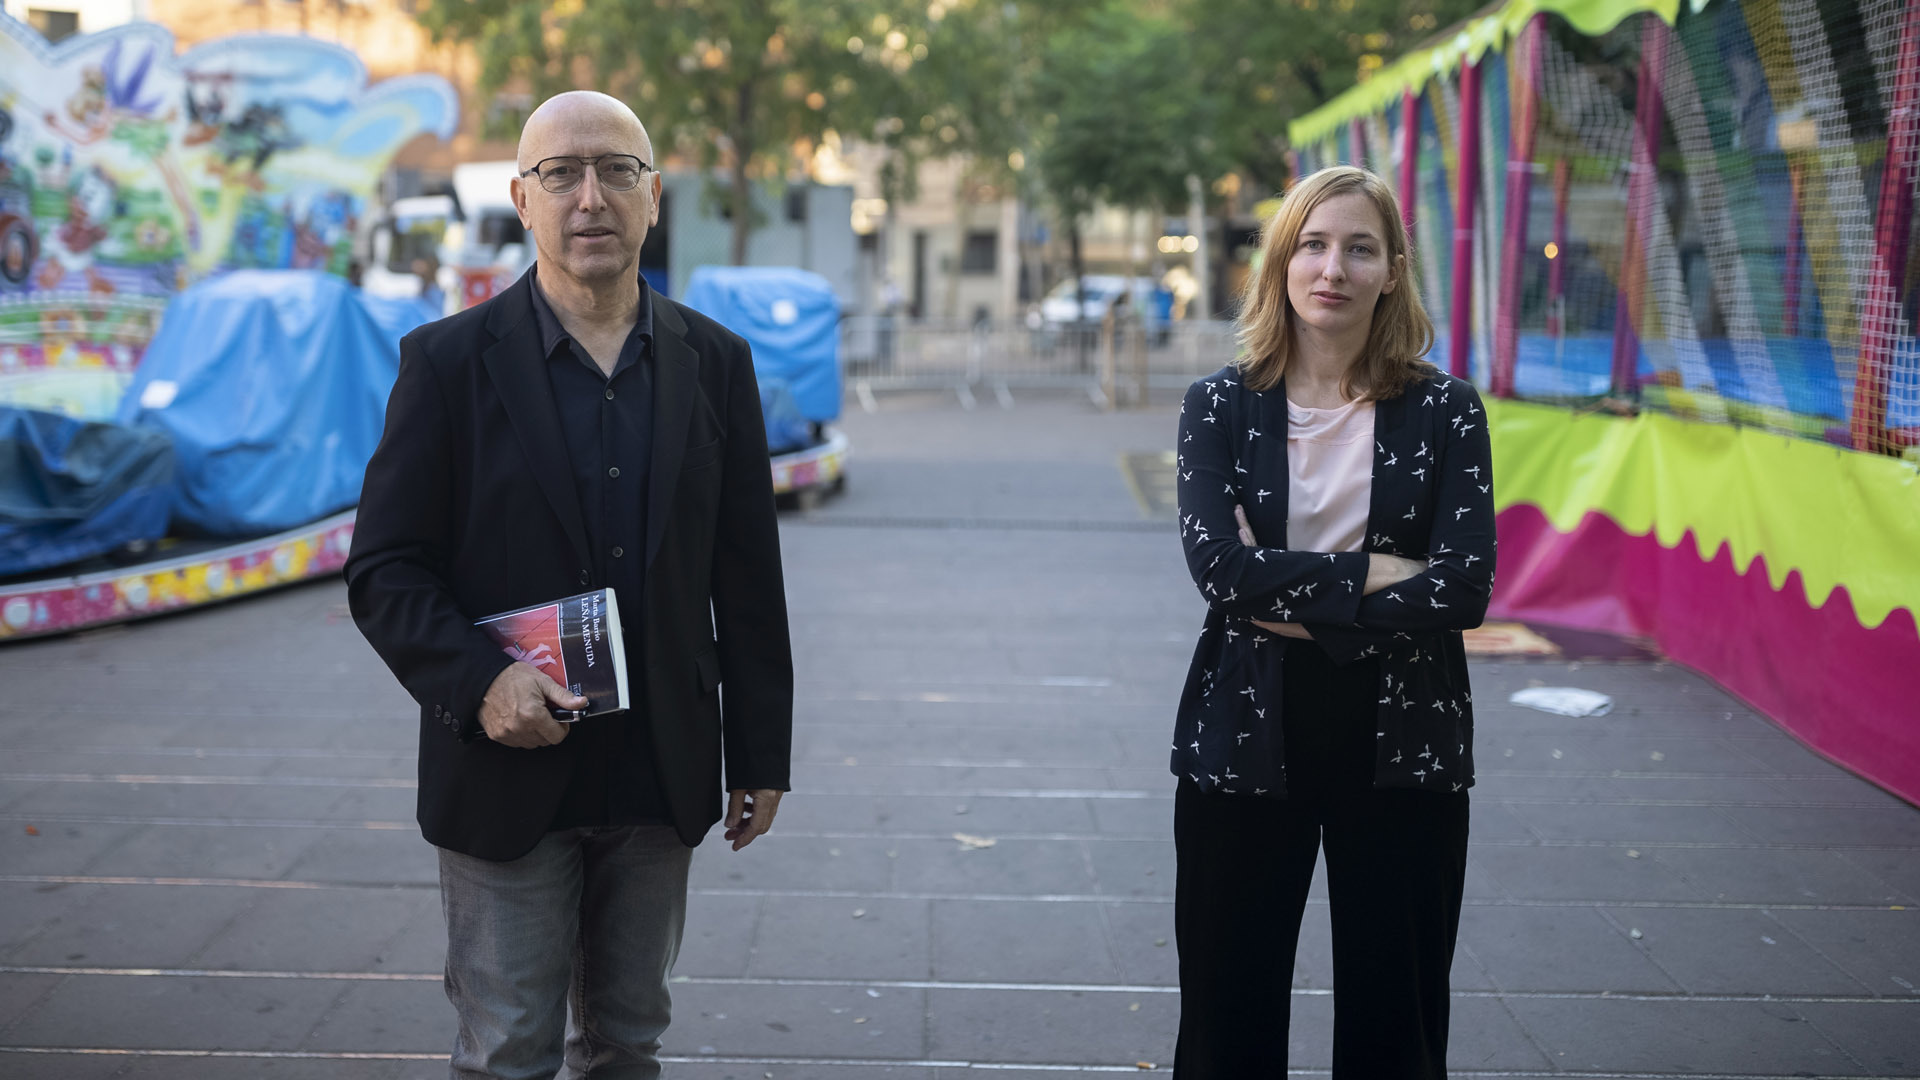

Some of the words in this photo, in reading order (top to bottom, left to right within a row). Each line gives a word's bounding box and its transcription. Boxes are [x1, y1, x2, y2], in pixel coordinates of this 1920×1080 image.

[581, 597, 589, 623] LEÑA
[592, 594, 600, 617] Marta
[592, 617, 600, 641] Barrio
[582, 624, 595, 668] MENUDA
